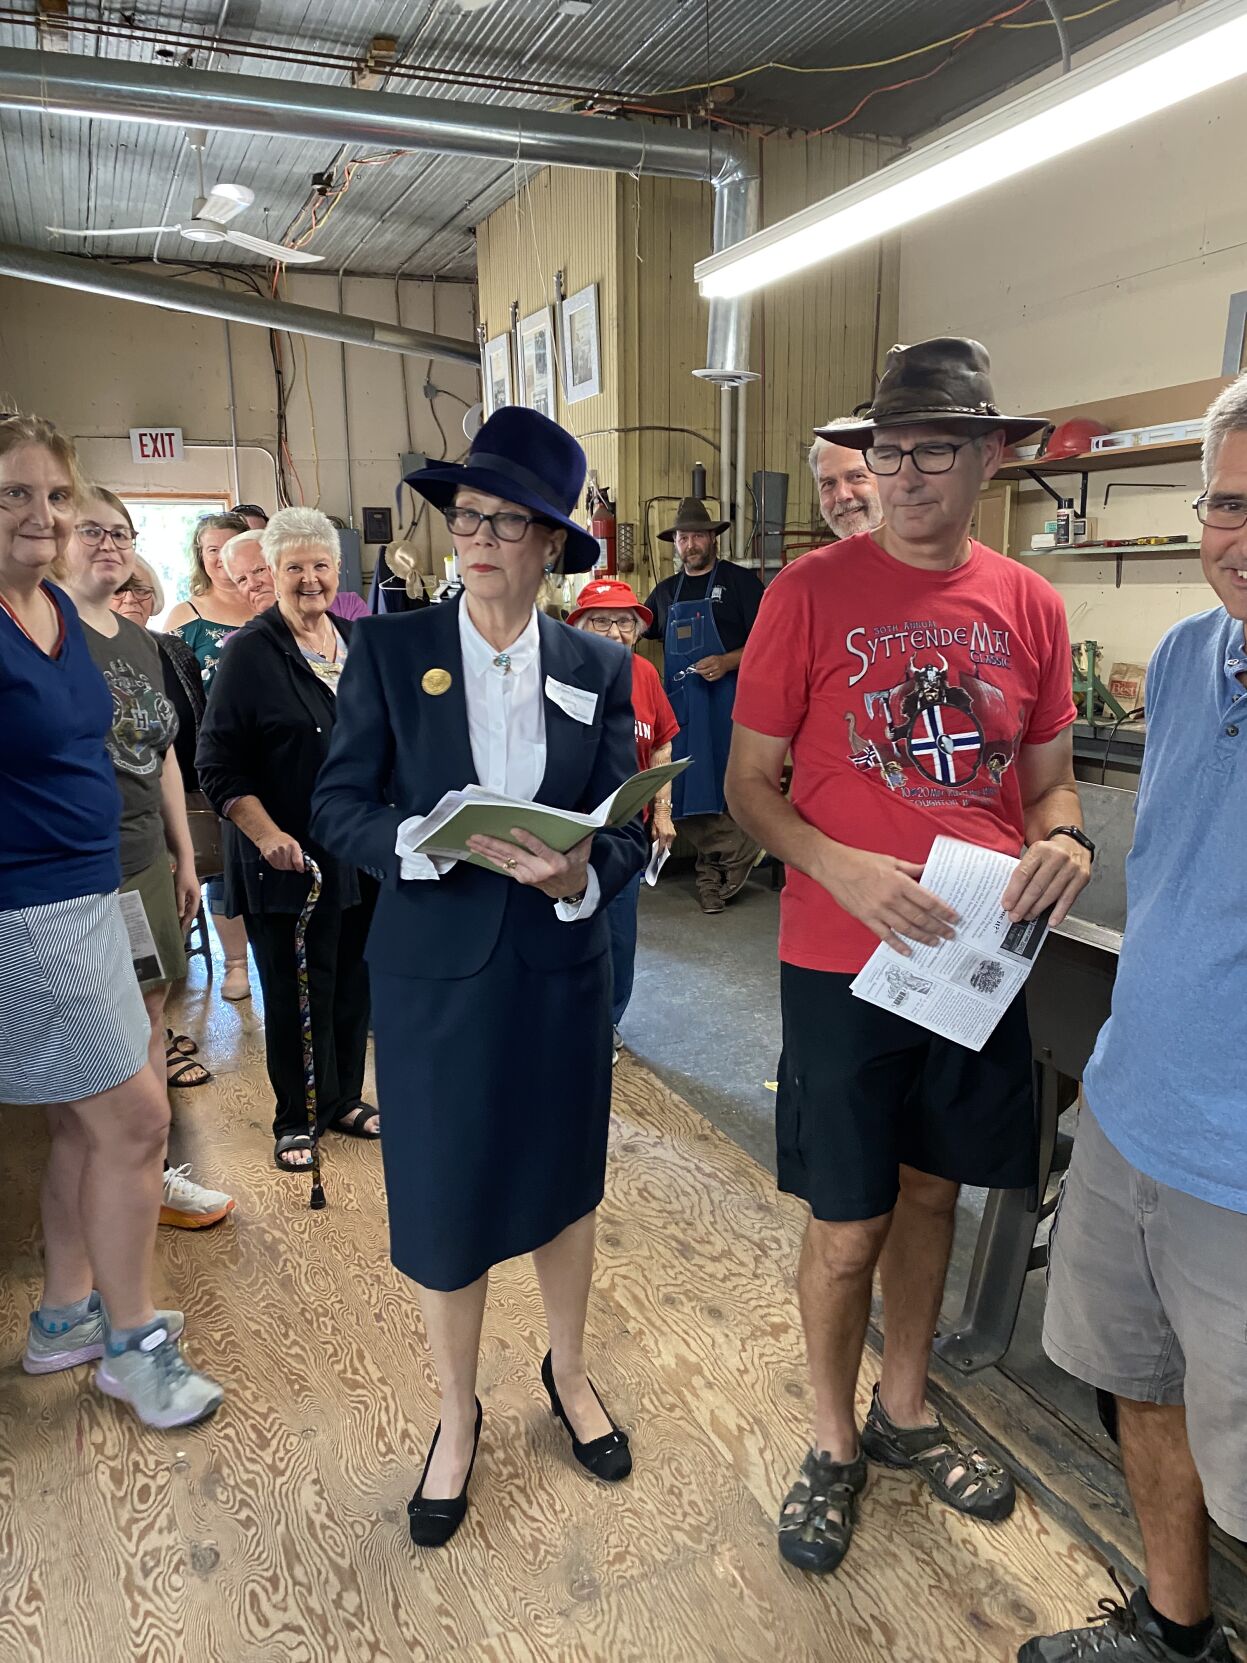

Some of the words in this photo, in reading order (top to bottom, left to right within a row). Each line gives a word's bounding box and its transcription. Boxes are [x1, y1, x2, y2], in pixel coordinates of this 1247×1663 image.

[138, 432, 175, 458] EXIT
[1111, 682, 1136, 697] Best
[917, 786, 930, 798] 20
